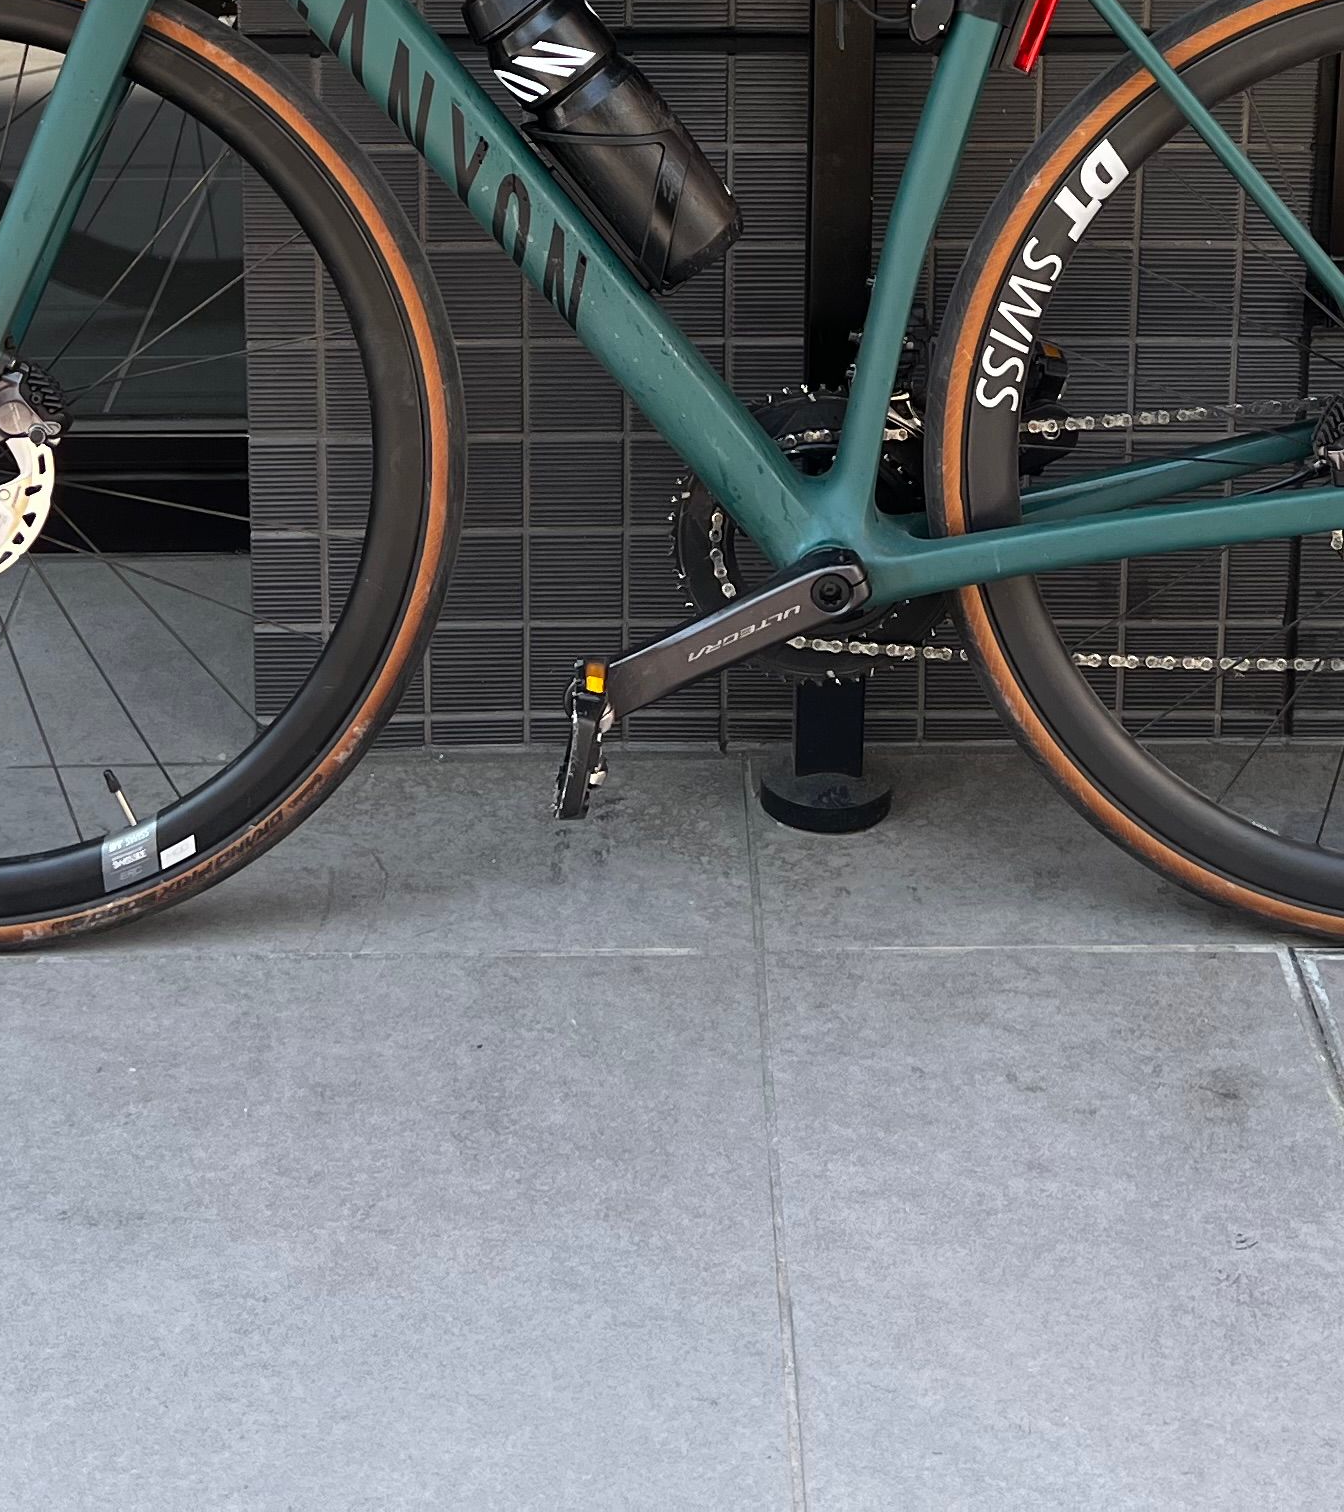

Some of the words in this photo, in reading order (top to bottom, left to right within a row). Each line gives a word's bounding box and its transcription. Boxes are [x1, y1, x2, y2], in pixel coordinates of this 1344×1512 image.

[1054, 138, 1130, 243] DT
[975, 236, 1063, 412] SWISS
[687, 605, 801, 663] ULTEGRA
